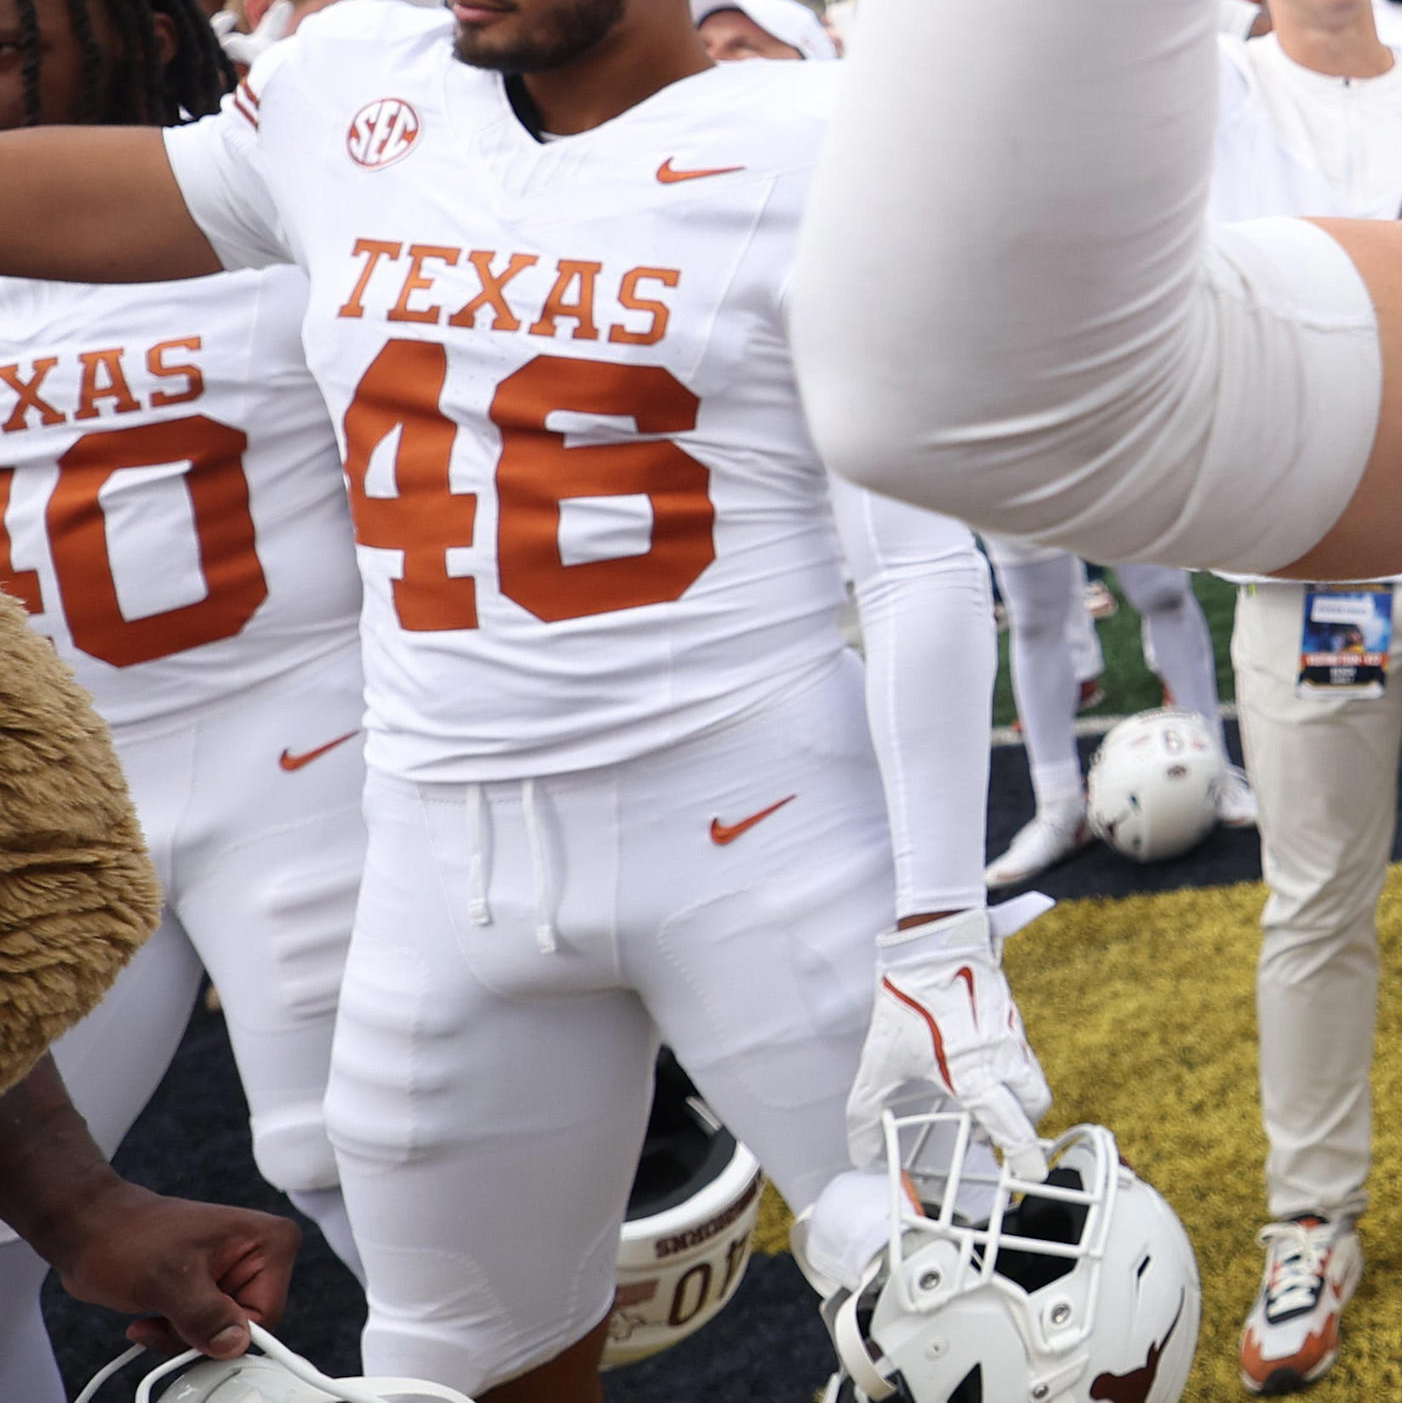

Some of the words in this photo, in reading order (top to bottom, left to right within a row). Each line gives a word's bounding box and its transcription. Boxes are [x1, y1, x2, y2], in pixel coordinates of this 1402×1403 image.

[350, 100, 417, 165] SEC
[338, 238, 681, 346] TEXAS
[0, 414, 269, 670] 0
[343, 338, 716, 632] 46
